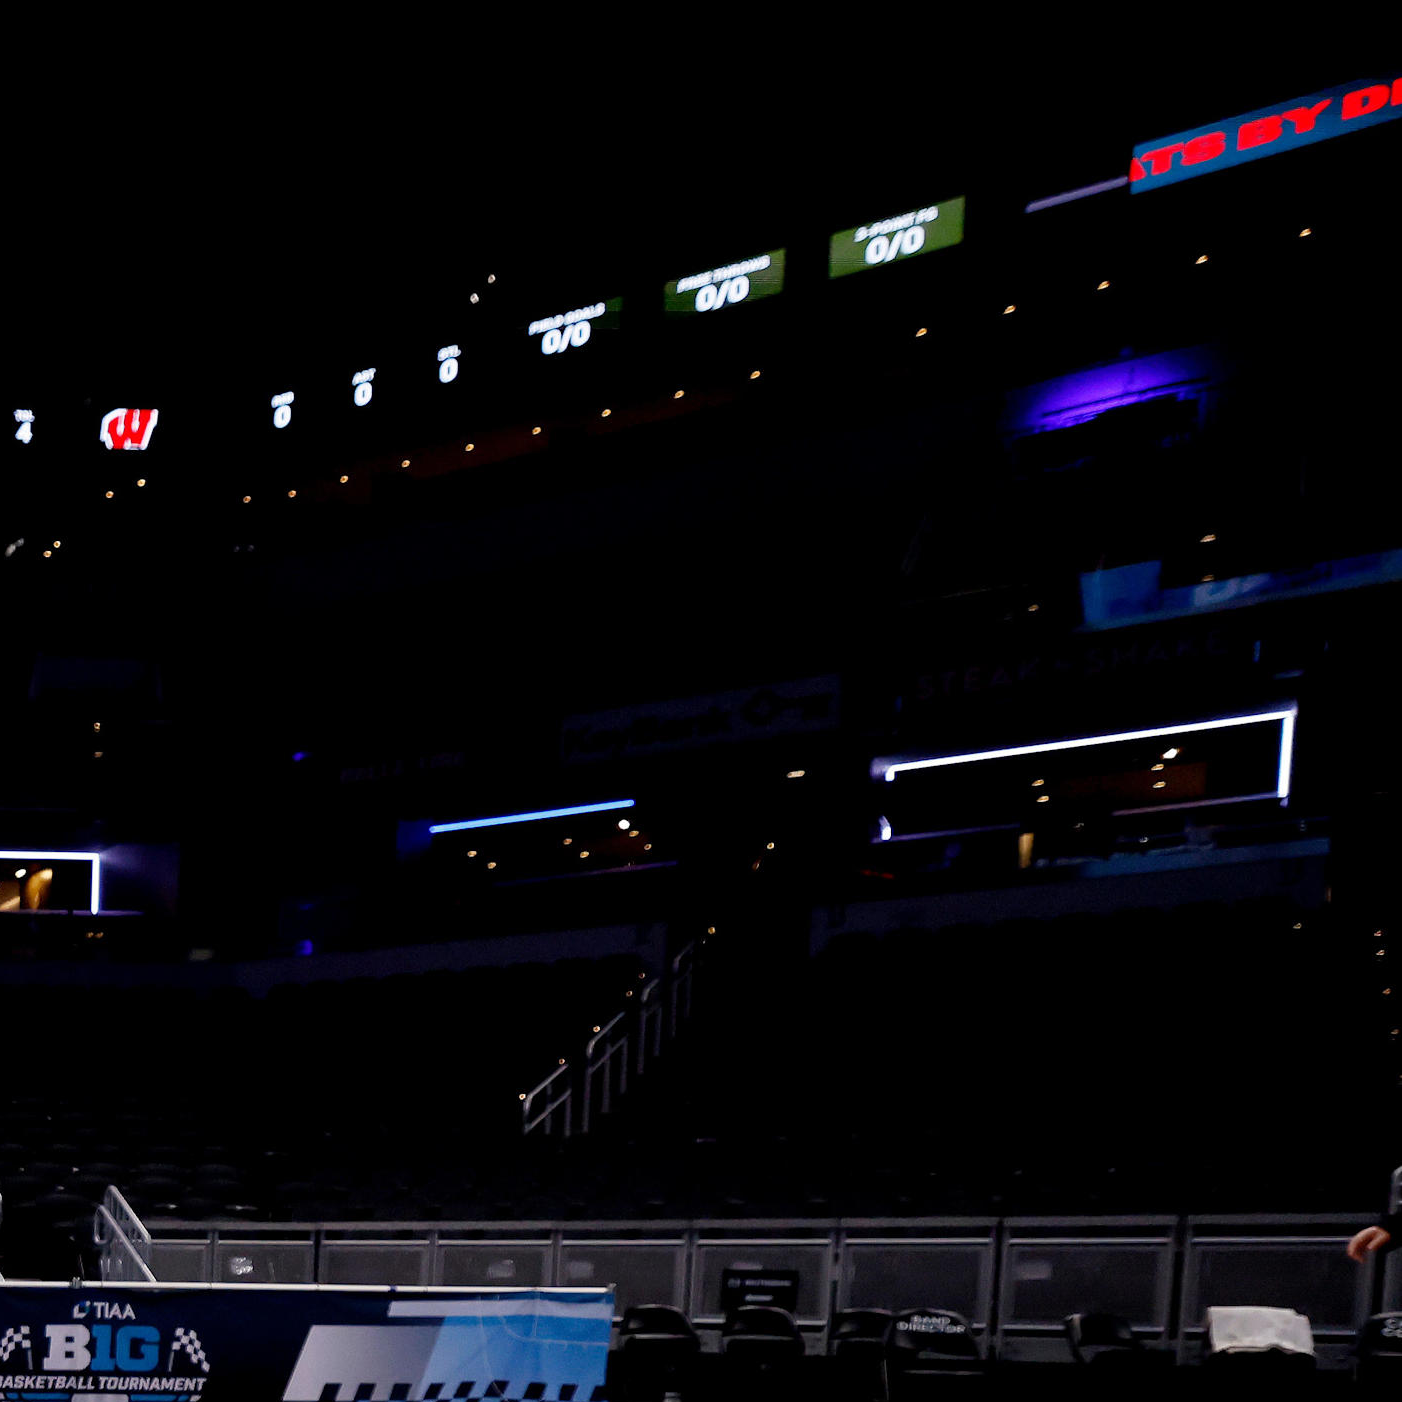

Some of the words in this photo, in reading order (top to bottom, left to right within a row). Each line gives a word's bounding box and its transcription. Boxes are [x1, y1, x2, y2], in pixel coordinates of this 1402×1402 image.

[1237, 98, 1333, 151] BY
[865, 225, 925, 264] 0/0
[695, 275, 750, 312] 0/0
[541, 320, 591, 354] 0/0
[439, 357, 458, 383] 0
[354, 382, 373, 406] 0
[100, 408, 159, 450] W
[273, 405, 292, 429] 0
[93, 1302, 137, 1320] TIAA
[98, 1376, 208, 1392] TOURNAMENT
